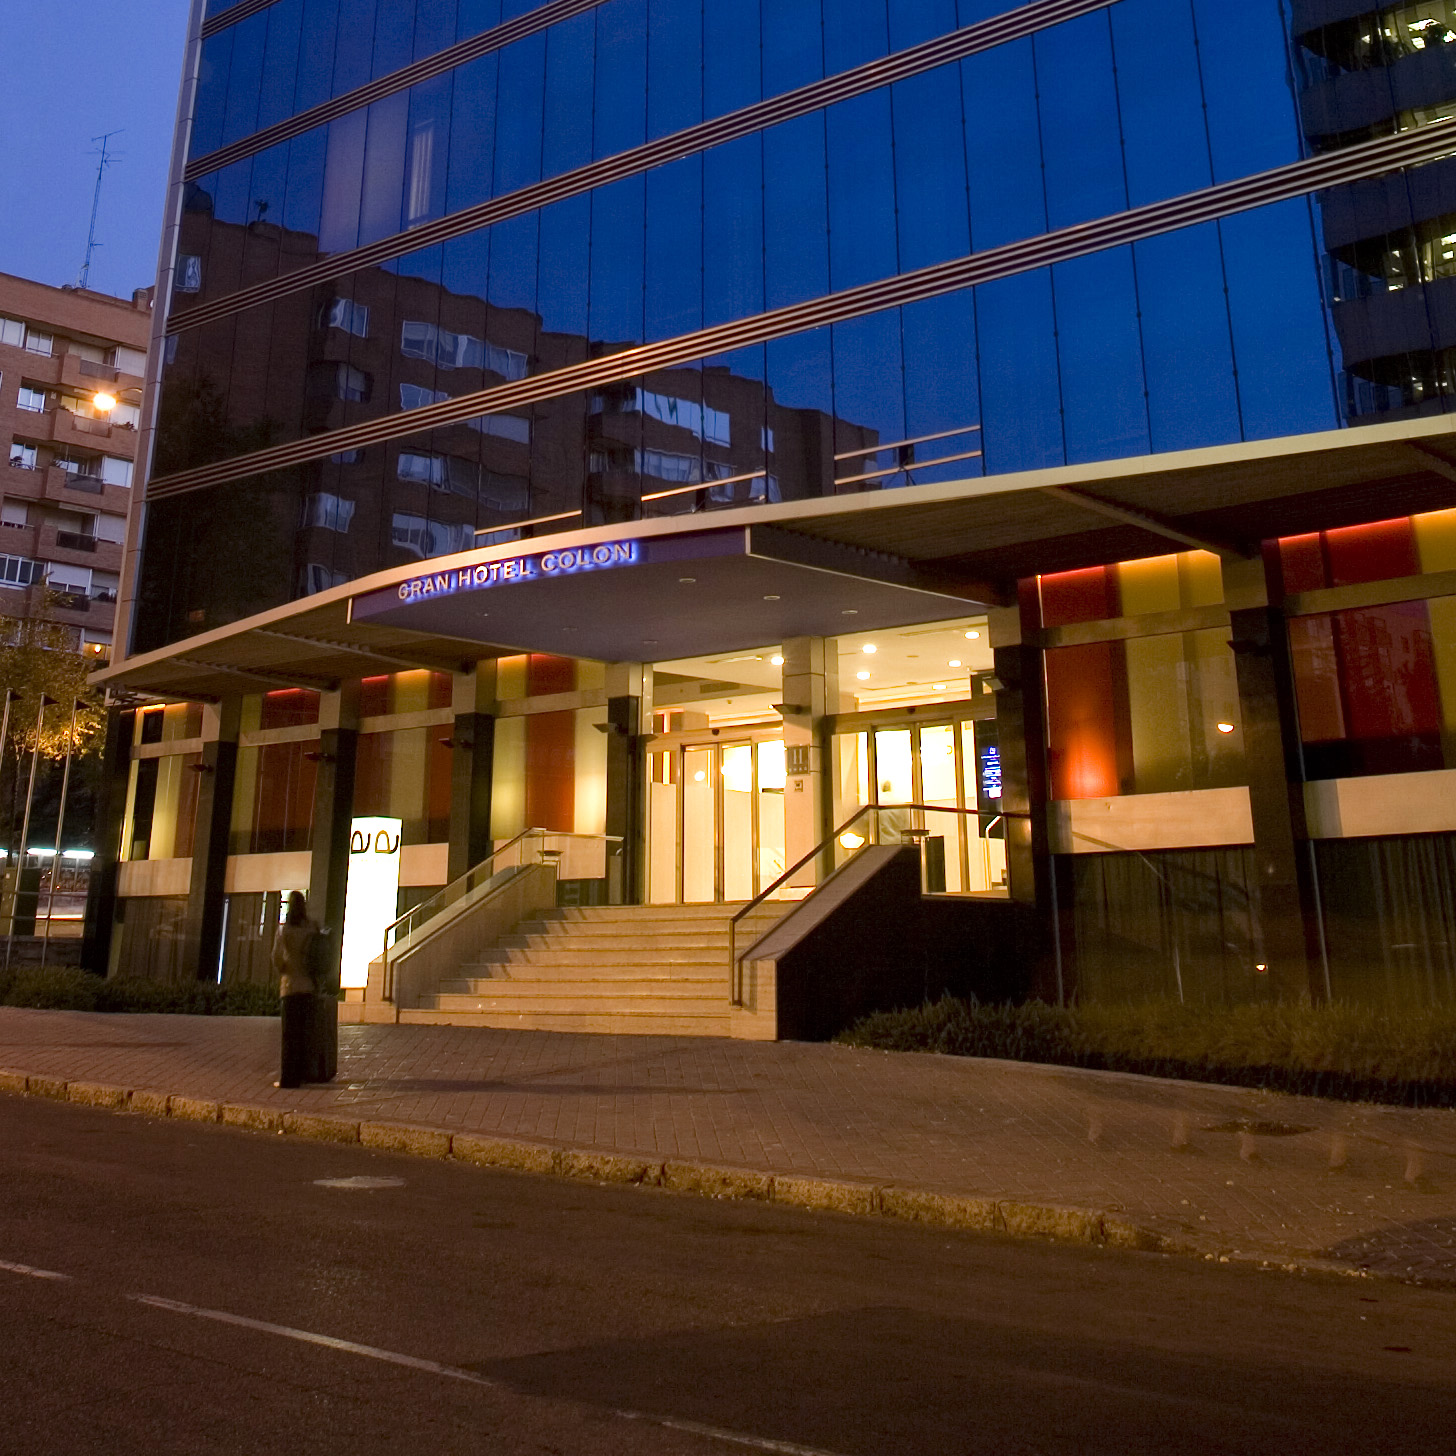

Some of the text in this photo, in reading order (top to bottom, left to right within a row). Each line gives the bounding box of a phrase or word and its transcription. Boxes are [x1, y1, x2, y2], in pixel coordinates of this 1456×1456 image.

[398, 542, 634, 601] GRAN HOTEL COLON
